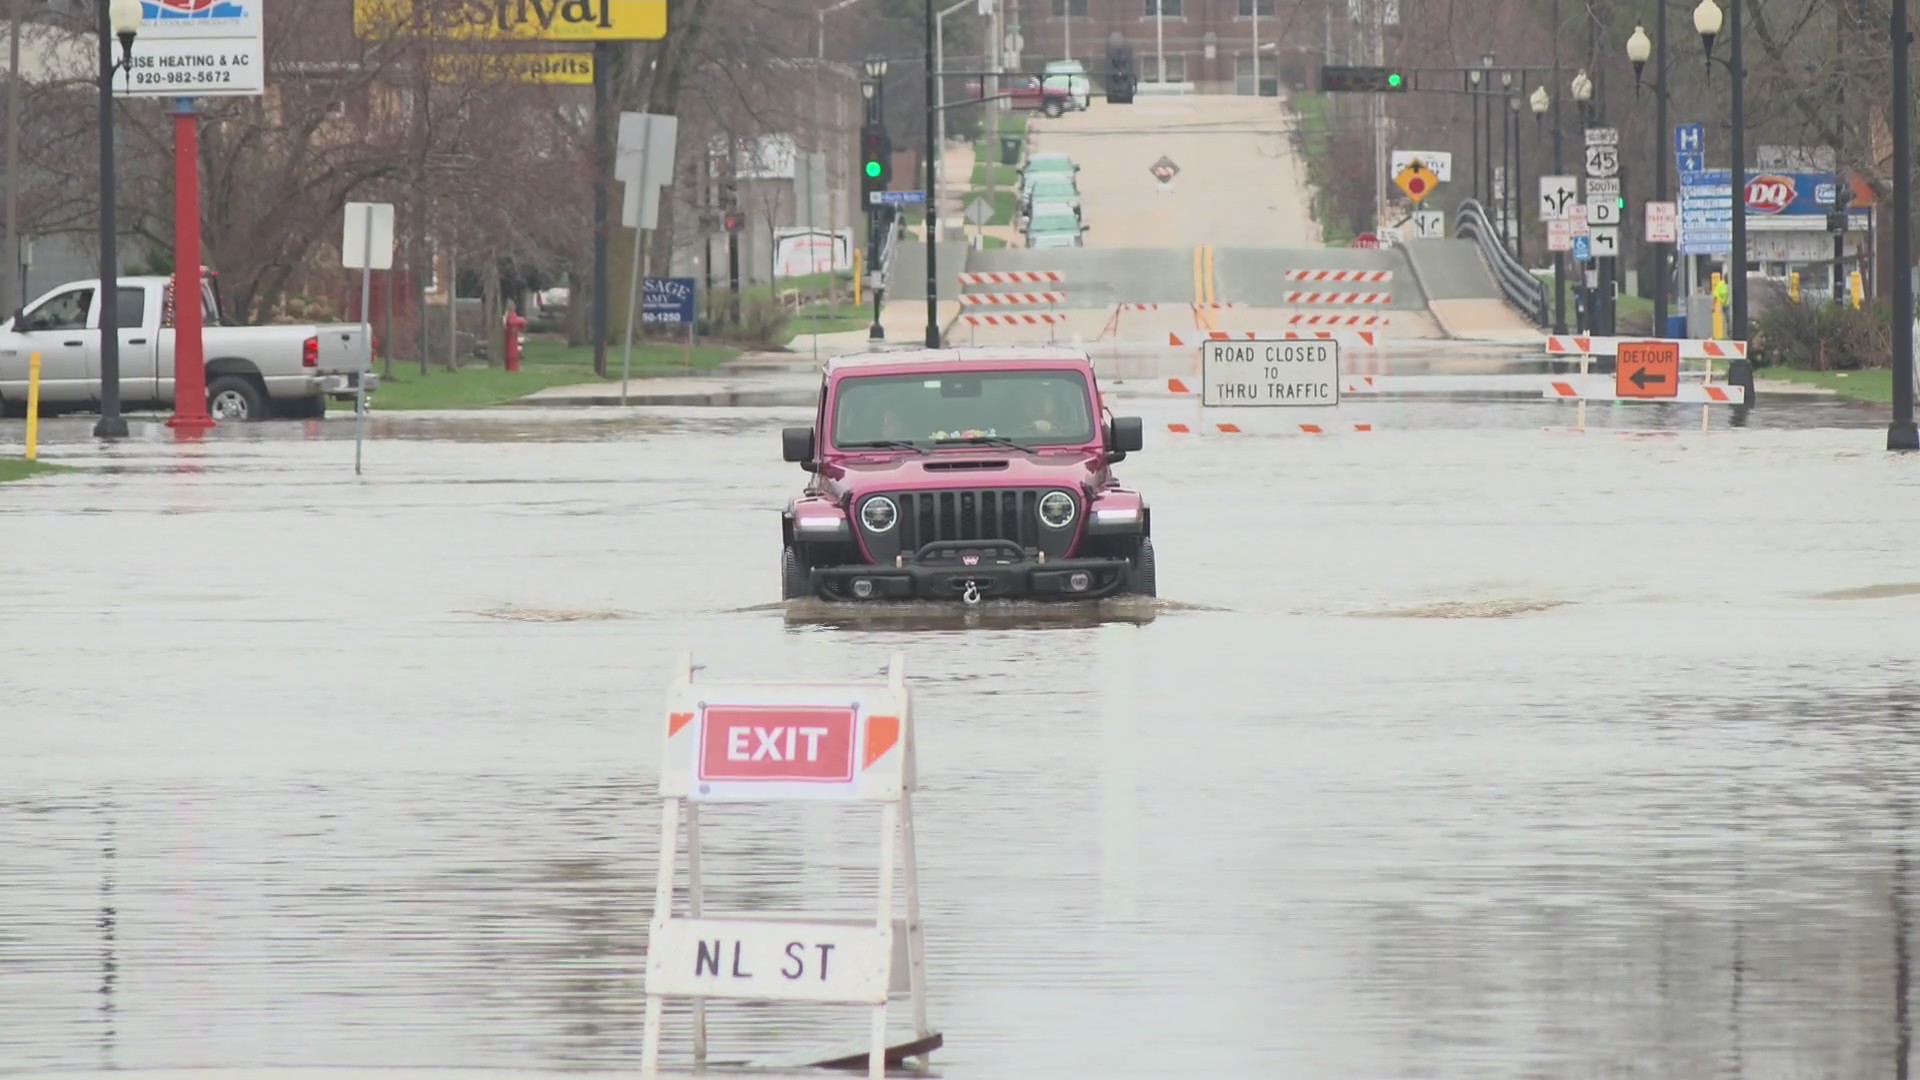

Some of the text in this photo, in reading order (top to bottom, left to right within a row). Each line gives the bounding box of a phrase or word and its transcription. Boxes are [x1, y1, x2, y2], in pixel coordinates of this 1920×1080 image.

[159, 56, 214, 67] HEATING
[219, 56, 227, 66] &
[232, 55, 249, 66] AC
[136, 71, 231, 84] 920-982-5672
[1680, 128, 1698, 150] H
[1590, 151, 1616, 170] 45
[1588, 182, 1617, 192] SOUTH
[1749, 183, 1788, 206] DQ
[1597, 205, 1609, 220] D
[1215, 346, 1326, 363] ROAD CLOSED
[1623, 350, 1673, 363] DETOUR
[1264, 367, 1278, 380] TO
[1217, 383, 1328, 399] THRU TRAFFIC
[727, 726, 828, 762] EXIT
[695, 939, 835, 981] NL ST
